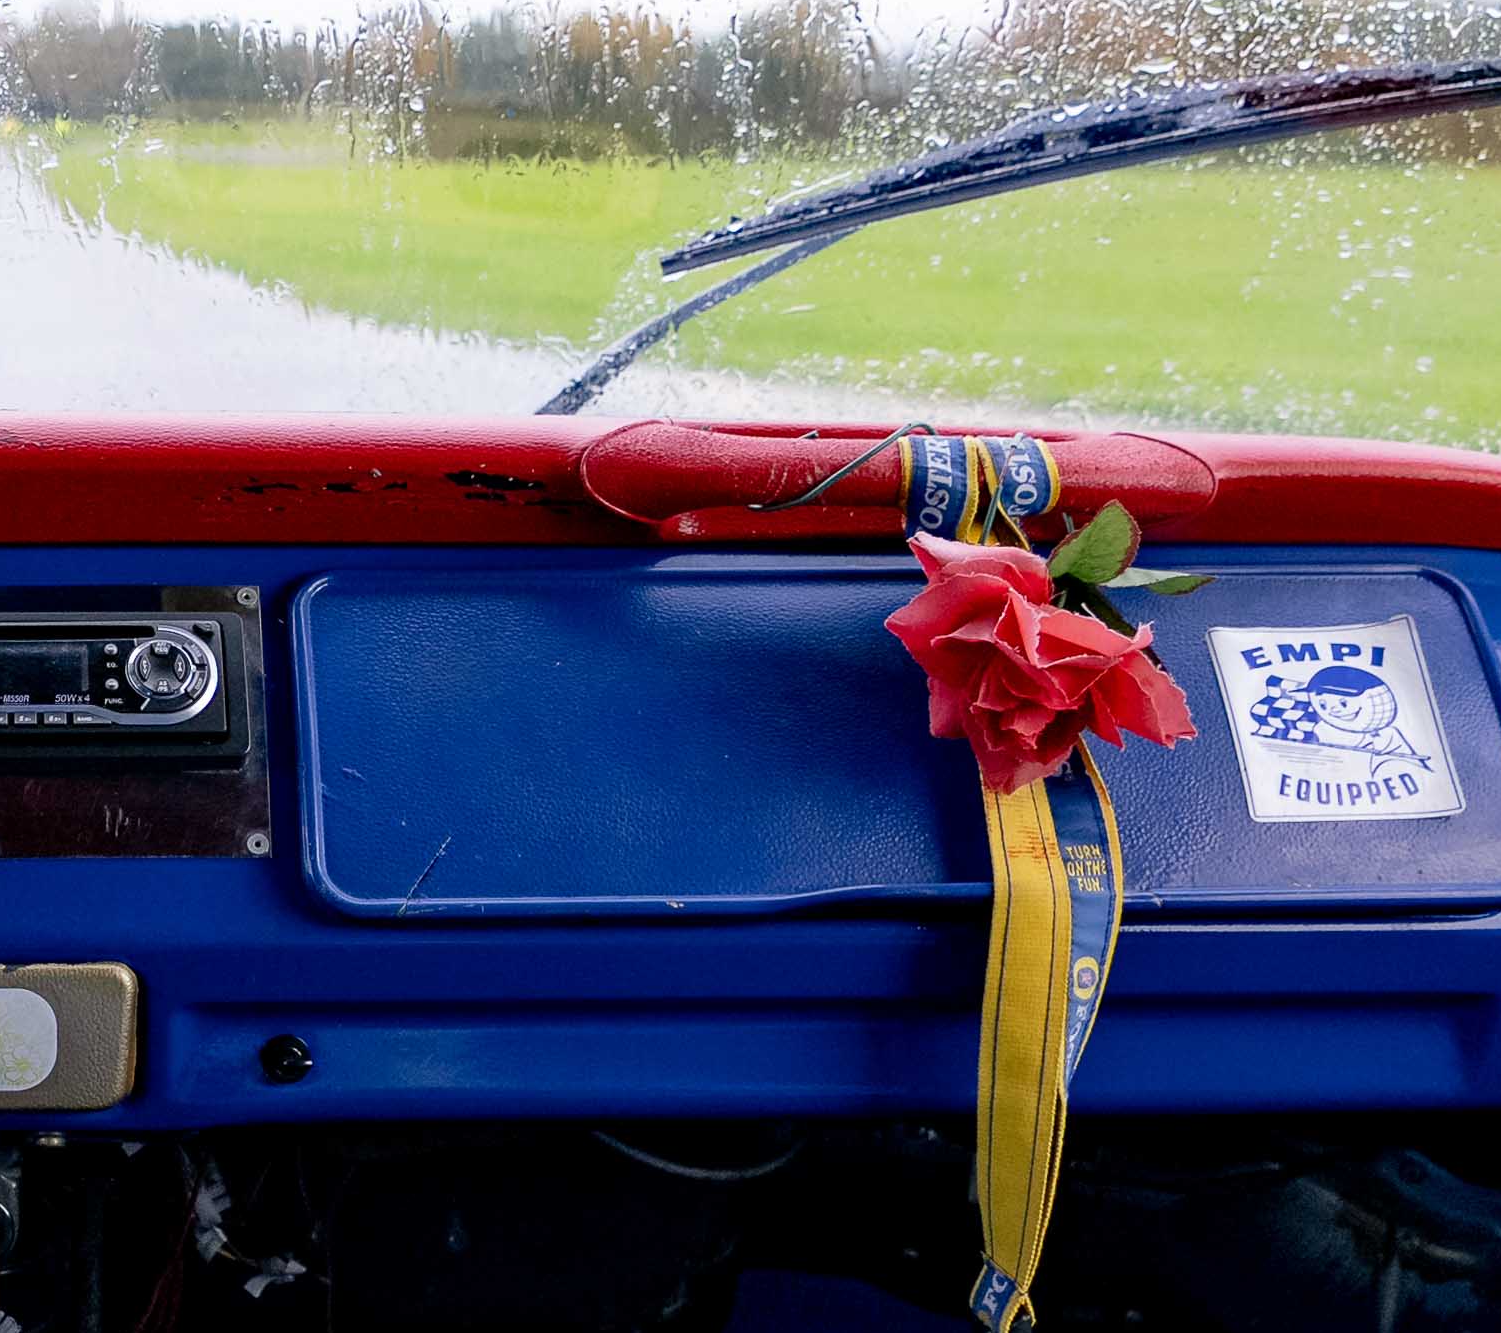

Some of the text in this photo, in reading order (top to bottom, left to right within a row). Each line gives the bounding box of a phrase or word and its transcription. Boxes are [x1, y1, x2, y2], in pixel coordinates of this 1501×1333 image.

[918, 436, 953, 530] OSTER
[1240, 642, 1386, 670] EMPI
[1279, 773, 1420, 806] EQUIPPED
[1065, 844, 1103, 860] TURN
[1067, 860, 1107, 876] ON THE
[1077, 877, 1105, 892] FUN.
